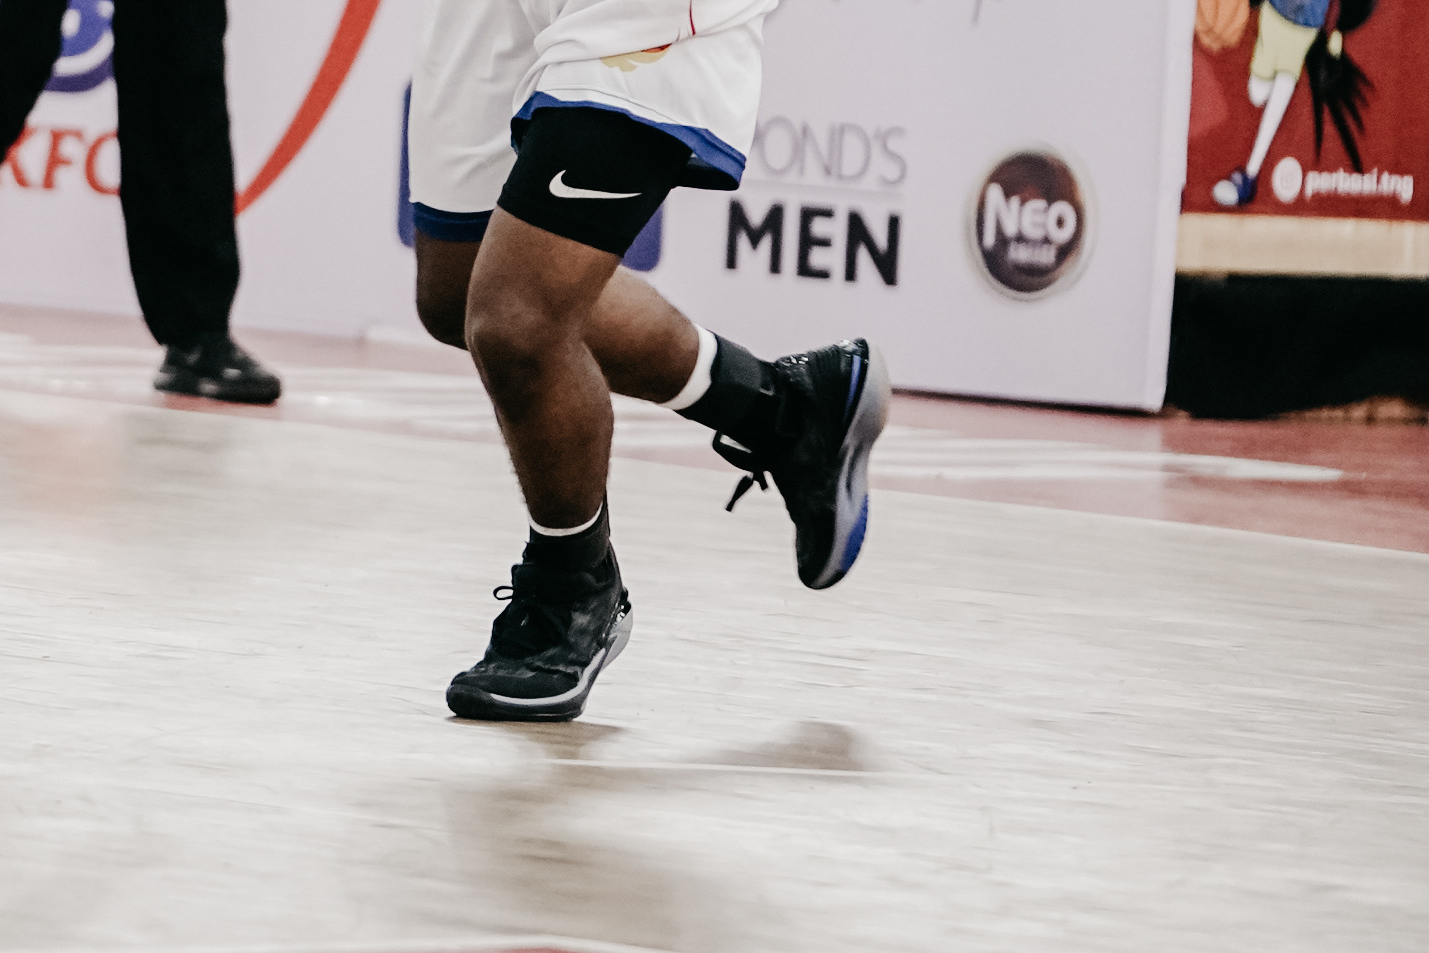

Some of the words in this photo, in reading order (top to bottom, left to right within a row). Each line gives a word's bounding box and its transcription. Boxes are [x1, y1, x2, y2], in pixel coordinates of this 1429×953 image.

[755, 114, 908, 187] OND'S
[725, 199, 901, 287] MEN
[983, 182, 1077, 248] NEO
